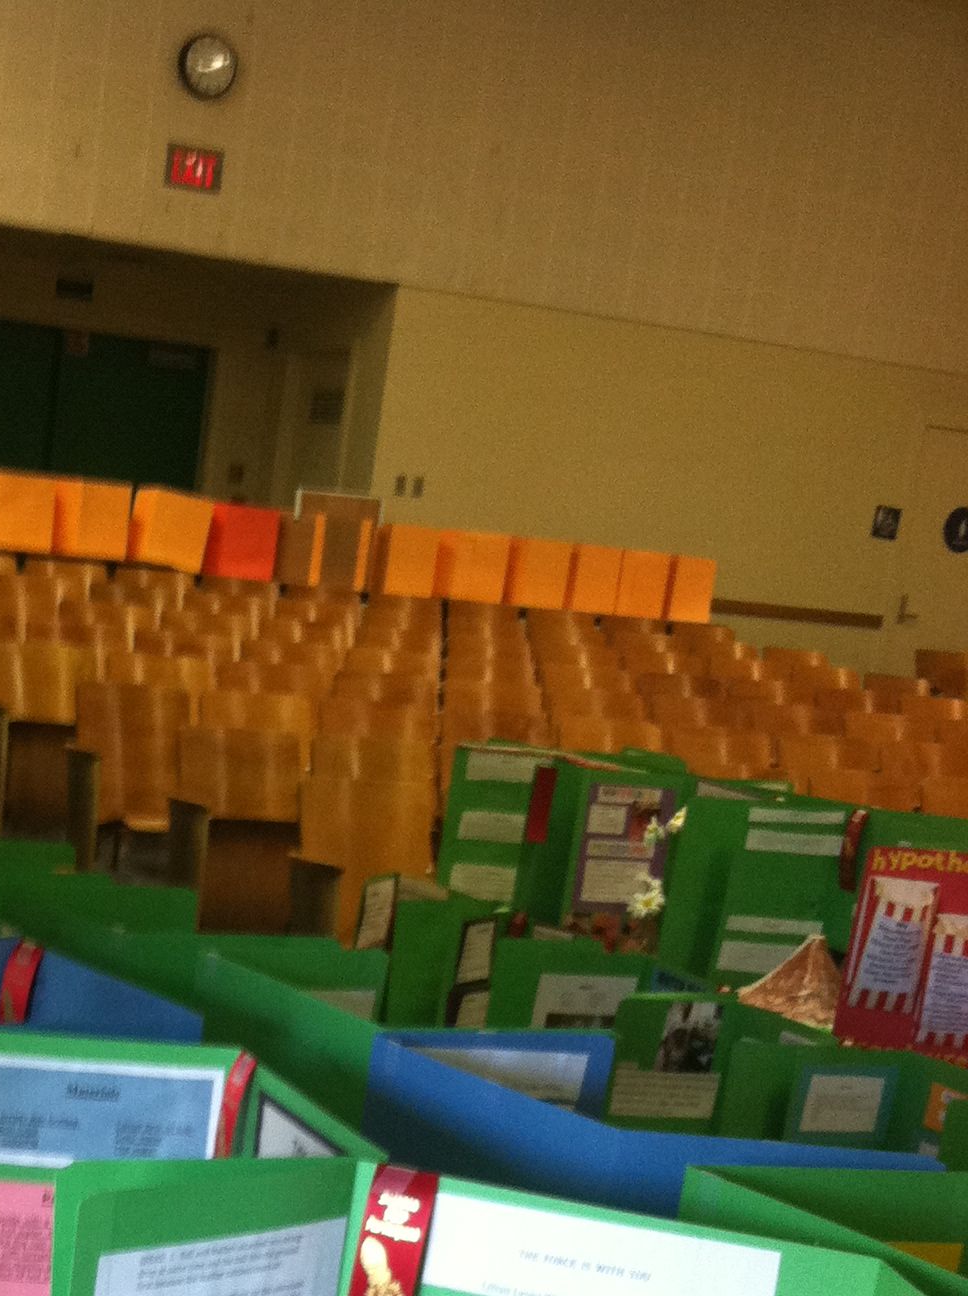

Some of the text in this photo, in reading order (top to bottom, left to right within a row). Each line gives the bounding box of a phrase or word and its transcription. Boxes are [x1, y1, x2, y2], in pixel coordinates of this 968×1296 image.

[171, 147, 217, 190] EXIT
[518, 1248, 539, 1263] THE
[542, 1252, 577, 1271] FORCE
[595, 1262, 625, 1278] WITH
[628, 1268, 653, 1283] YOU
